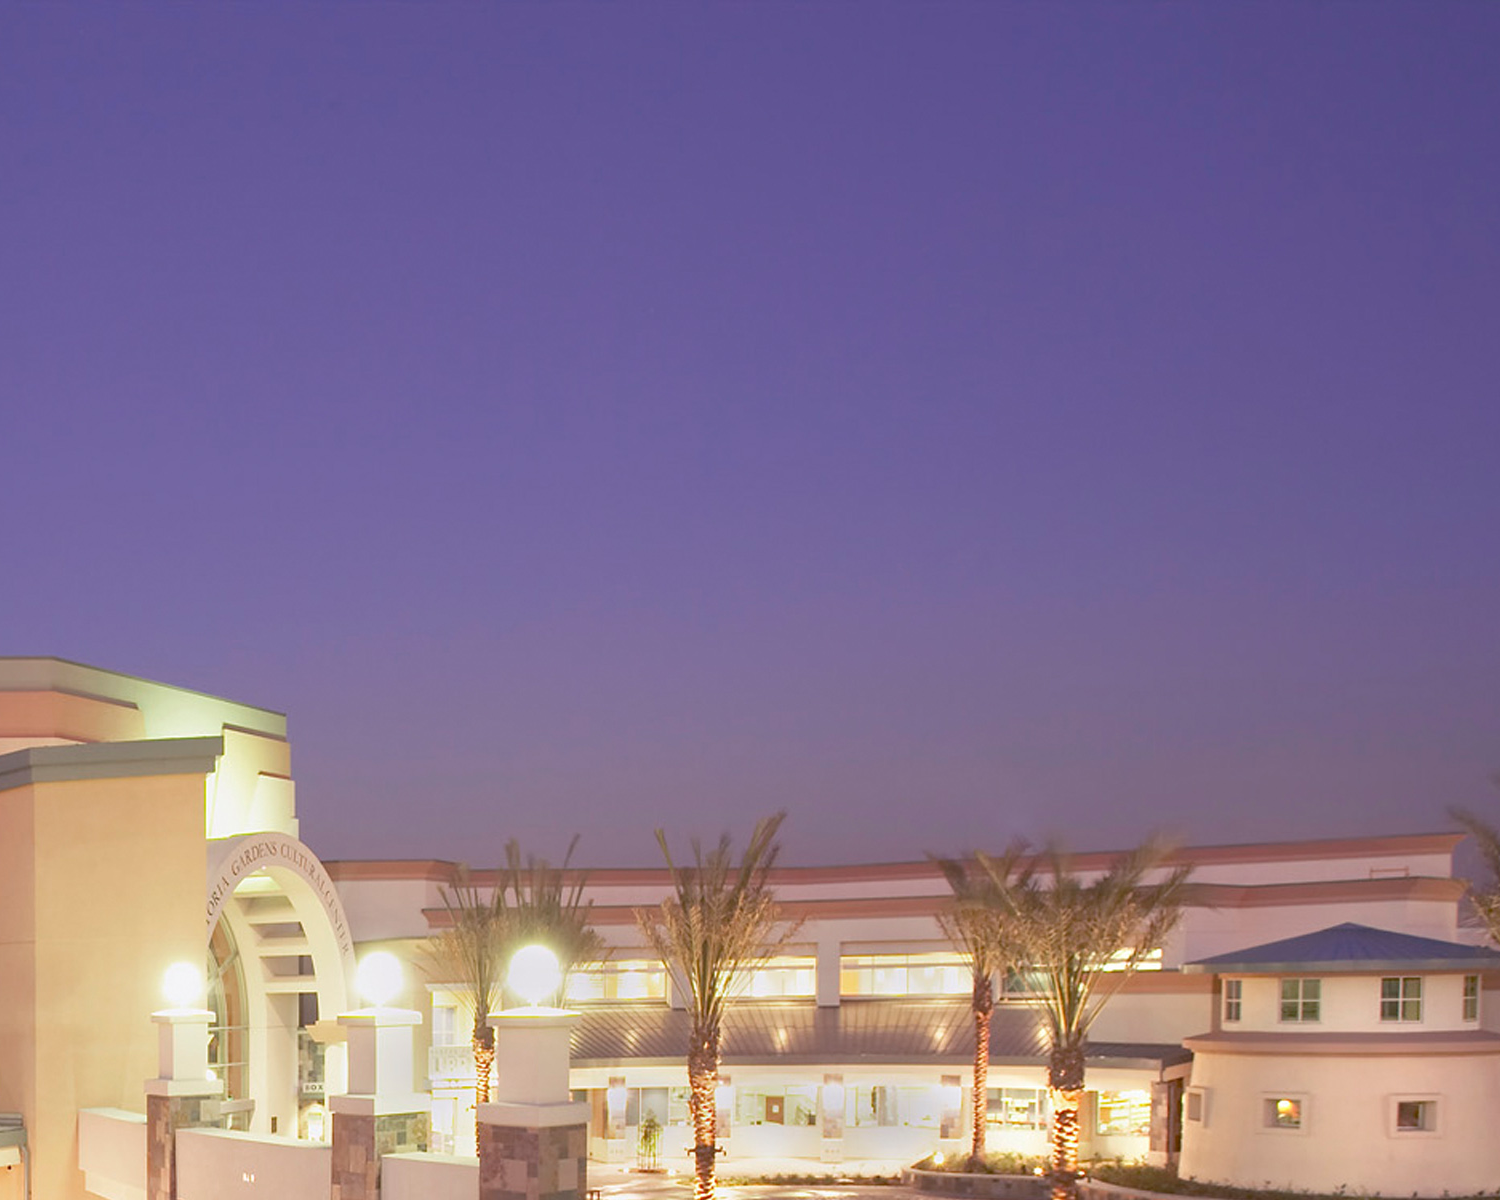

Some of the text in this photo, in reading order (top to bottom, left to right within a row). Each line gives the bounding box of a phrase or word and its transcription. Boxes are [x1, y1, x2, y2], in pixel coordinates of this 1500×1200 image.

[206, 877, 230, 925] ORIA
[231, 841, 278, 876] GARDENS
[280, 843, 326, 895] CULTURAL
